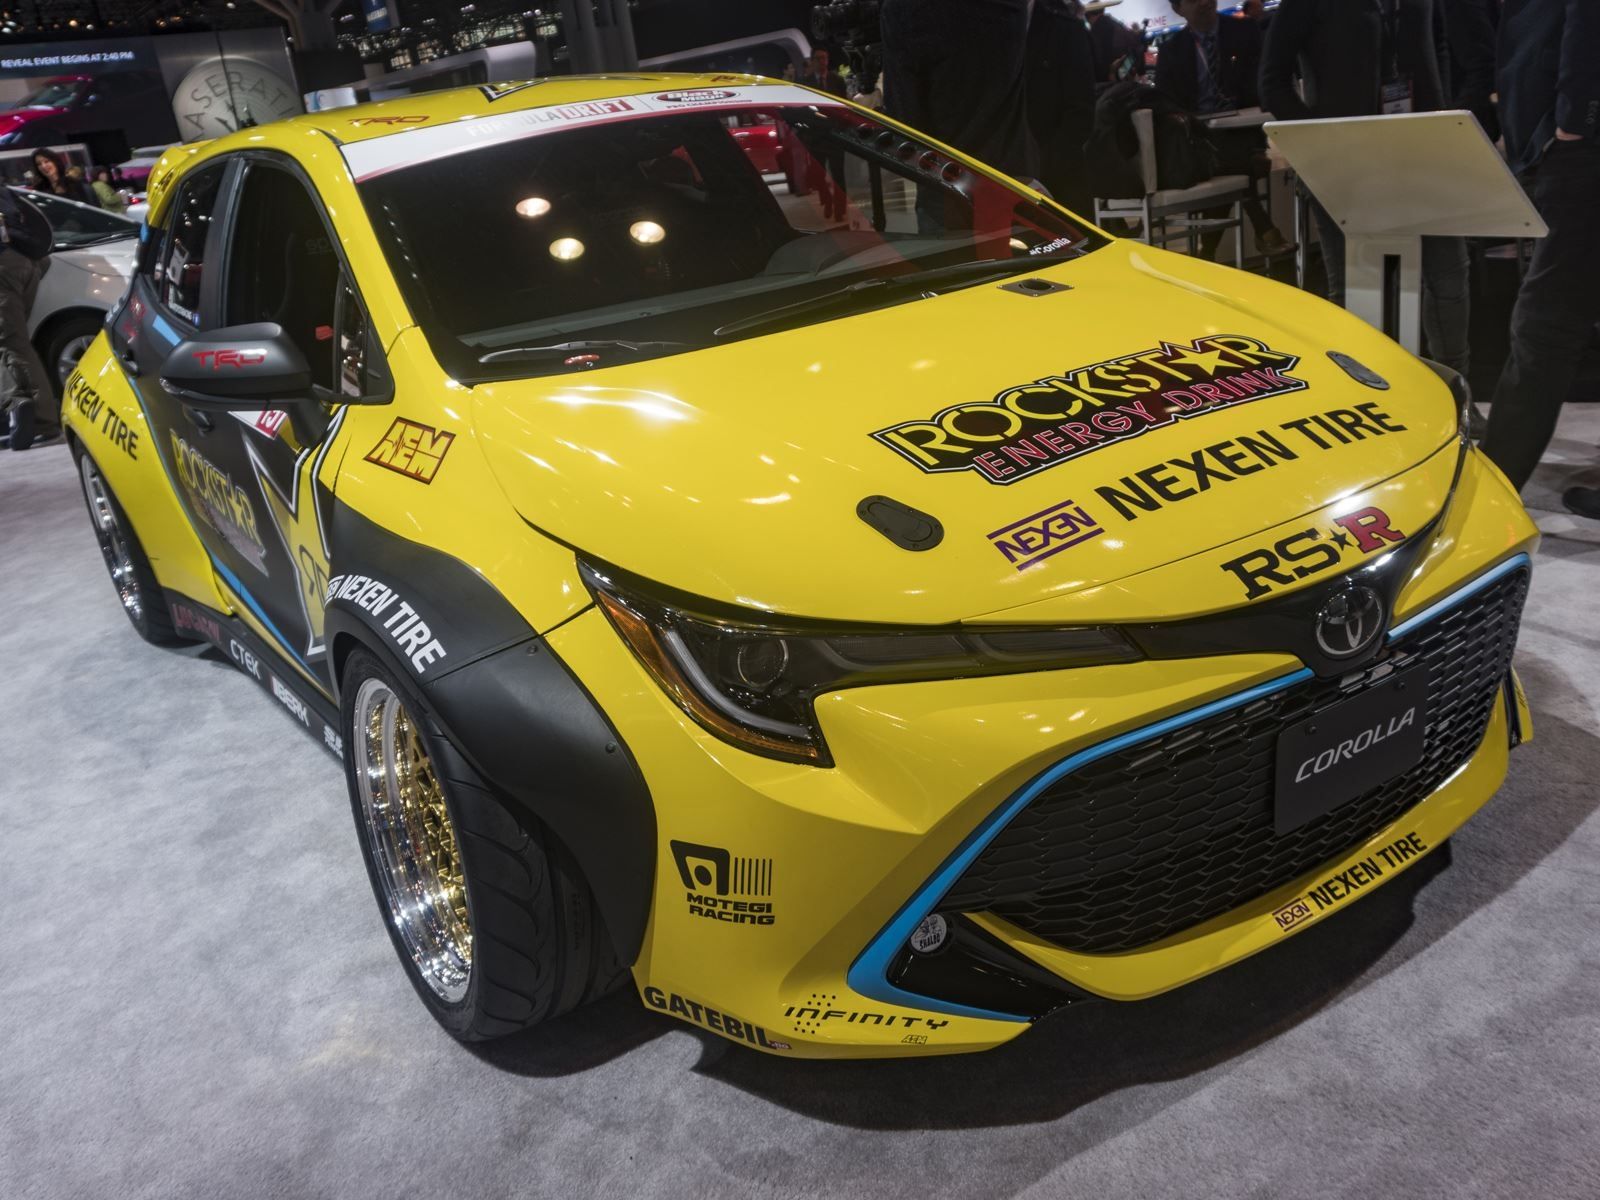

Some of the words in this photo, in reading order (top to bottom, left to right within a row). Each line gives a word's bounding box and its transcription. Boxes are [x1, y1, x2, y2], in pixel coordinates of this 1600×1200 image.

[1, 58, 33, 68] REVEAL
[34, 56, 60, 66] EVENT
[61, 54, 91, 64] BEGINS
[91, 53, 101, 62] AT
[120, 51, 134, 60] PM
[183, 71, 295, 141] ASERATI
[349, 115, 430, 126] TRD
[466, 111, 562, 136] FORULA
[557, 99, 633, 120] DRIFT
[1029, 237, 1071, 255] #Corolla
[192, 349, 266, 370] TRD
[65, 370, 105, 424] NEXEN
[102, 406, 139, 461] TIRE
[973, 400, 1157, 478] ENERGY
[1161, 367, 1297, 411] DRINK
[363, 416, 456, 485] AEM
[991, 504, 1100, 566] NEXEN
[1094, 430, 1299, 522] NEXEN
[1279, 402, 1409, 450] TIRE
[334, 574, 399, 617] NEXEN
[383, 601, 447, 674] TIRE
[230, 639, 262, 681] CTEK
[1295, 707, 1416, 784] COROLLA
[687, 892, 773, 914] MOTEGI
[1273, 899, 1312, 929] NEXEN
[1307, 856, 1384, 911] NEXEN
[1376, 832, 1428, 869] TIRE
[689, 904, 776, 926] RACING
[643, 986, 773, 1049] GATEBIL
[784, 1006, 950, 1031] INFINITY
